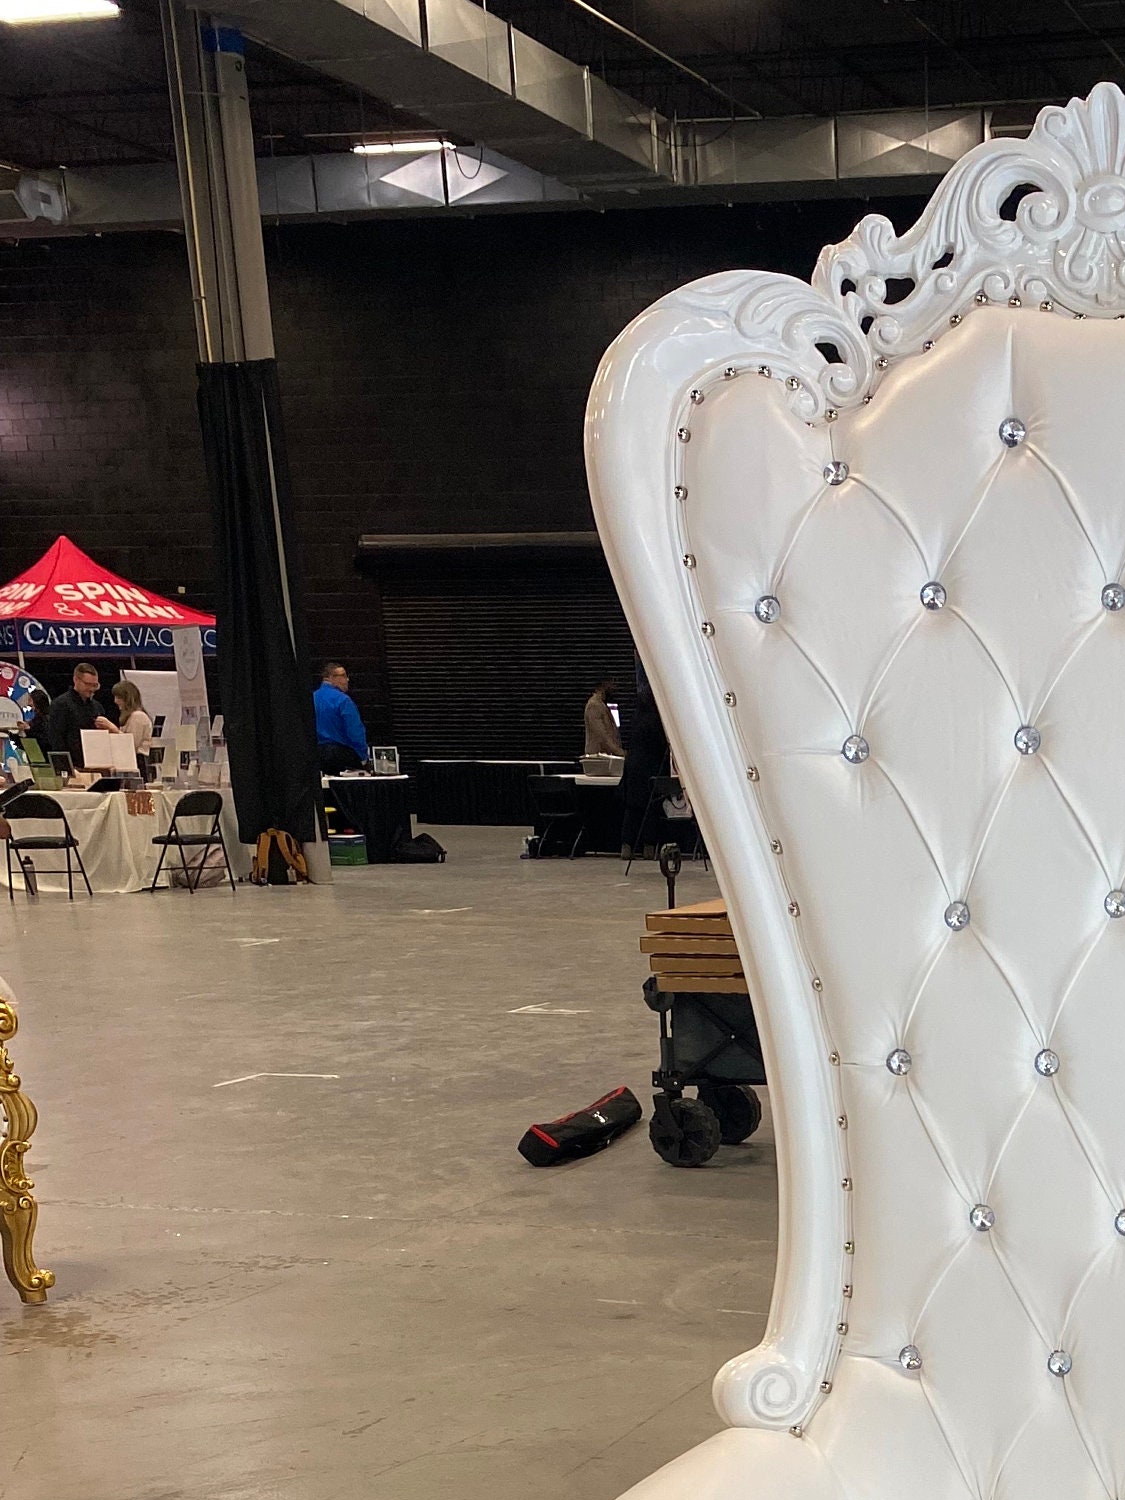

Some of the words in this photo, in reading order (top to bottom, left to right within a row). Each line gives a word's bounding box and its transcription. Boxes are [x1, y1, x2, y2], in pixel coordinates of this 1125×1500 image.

[53, 581, 150, 604] SPIN
[53, 602, 85, 617] &
[82, 600, 185, 619] WIN!
